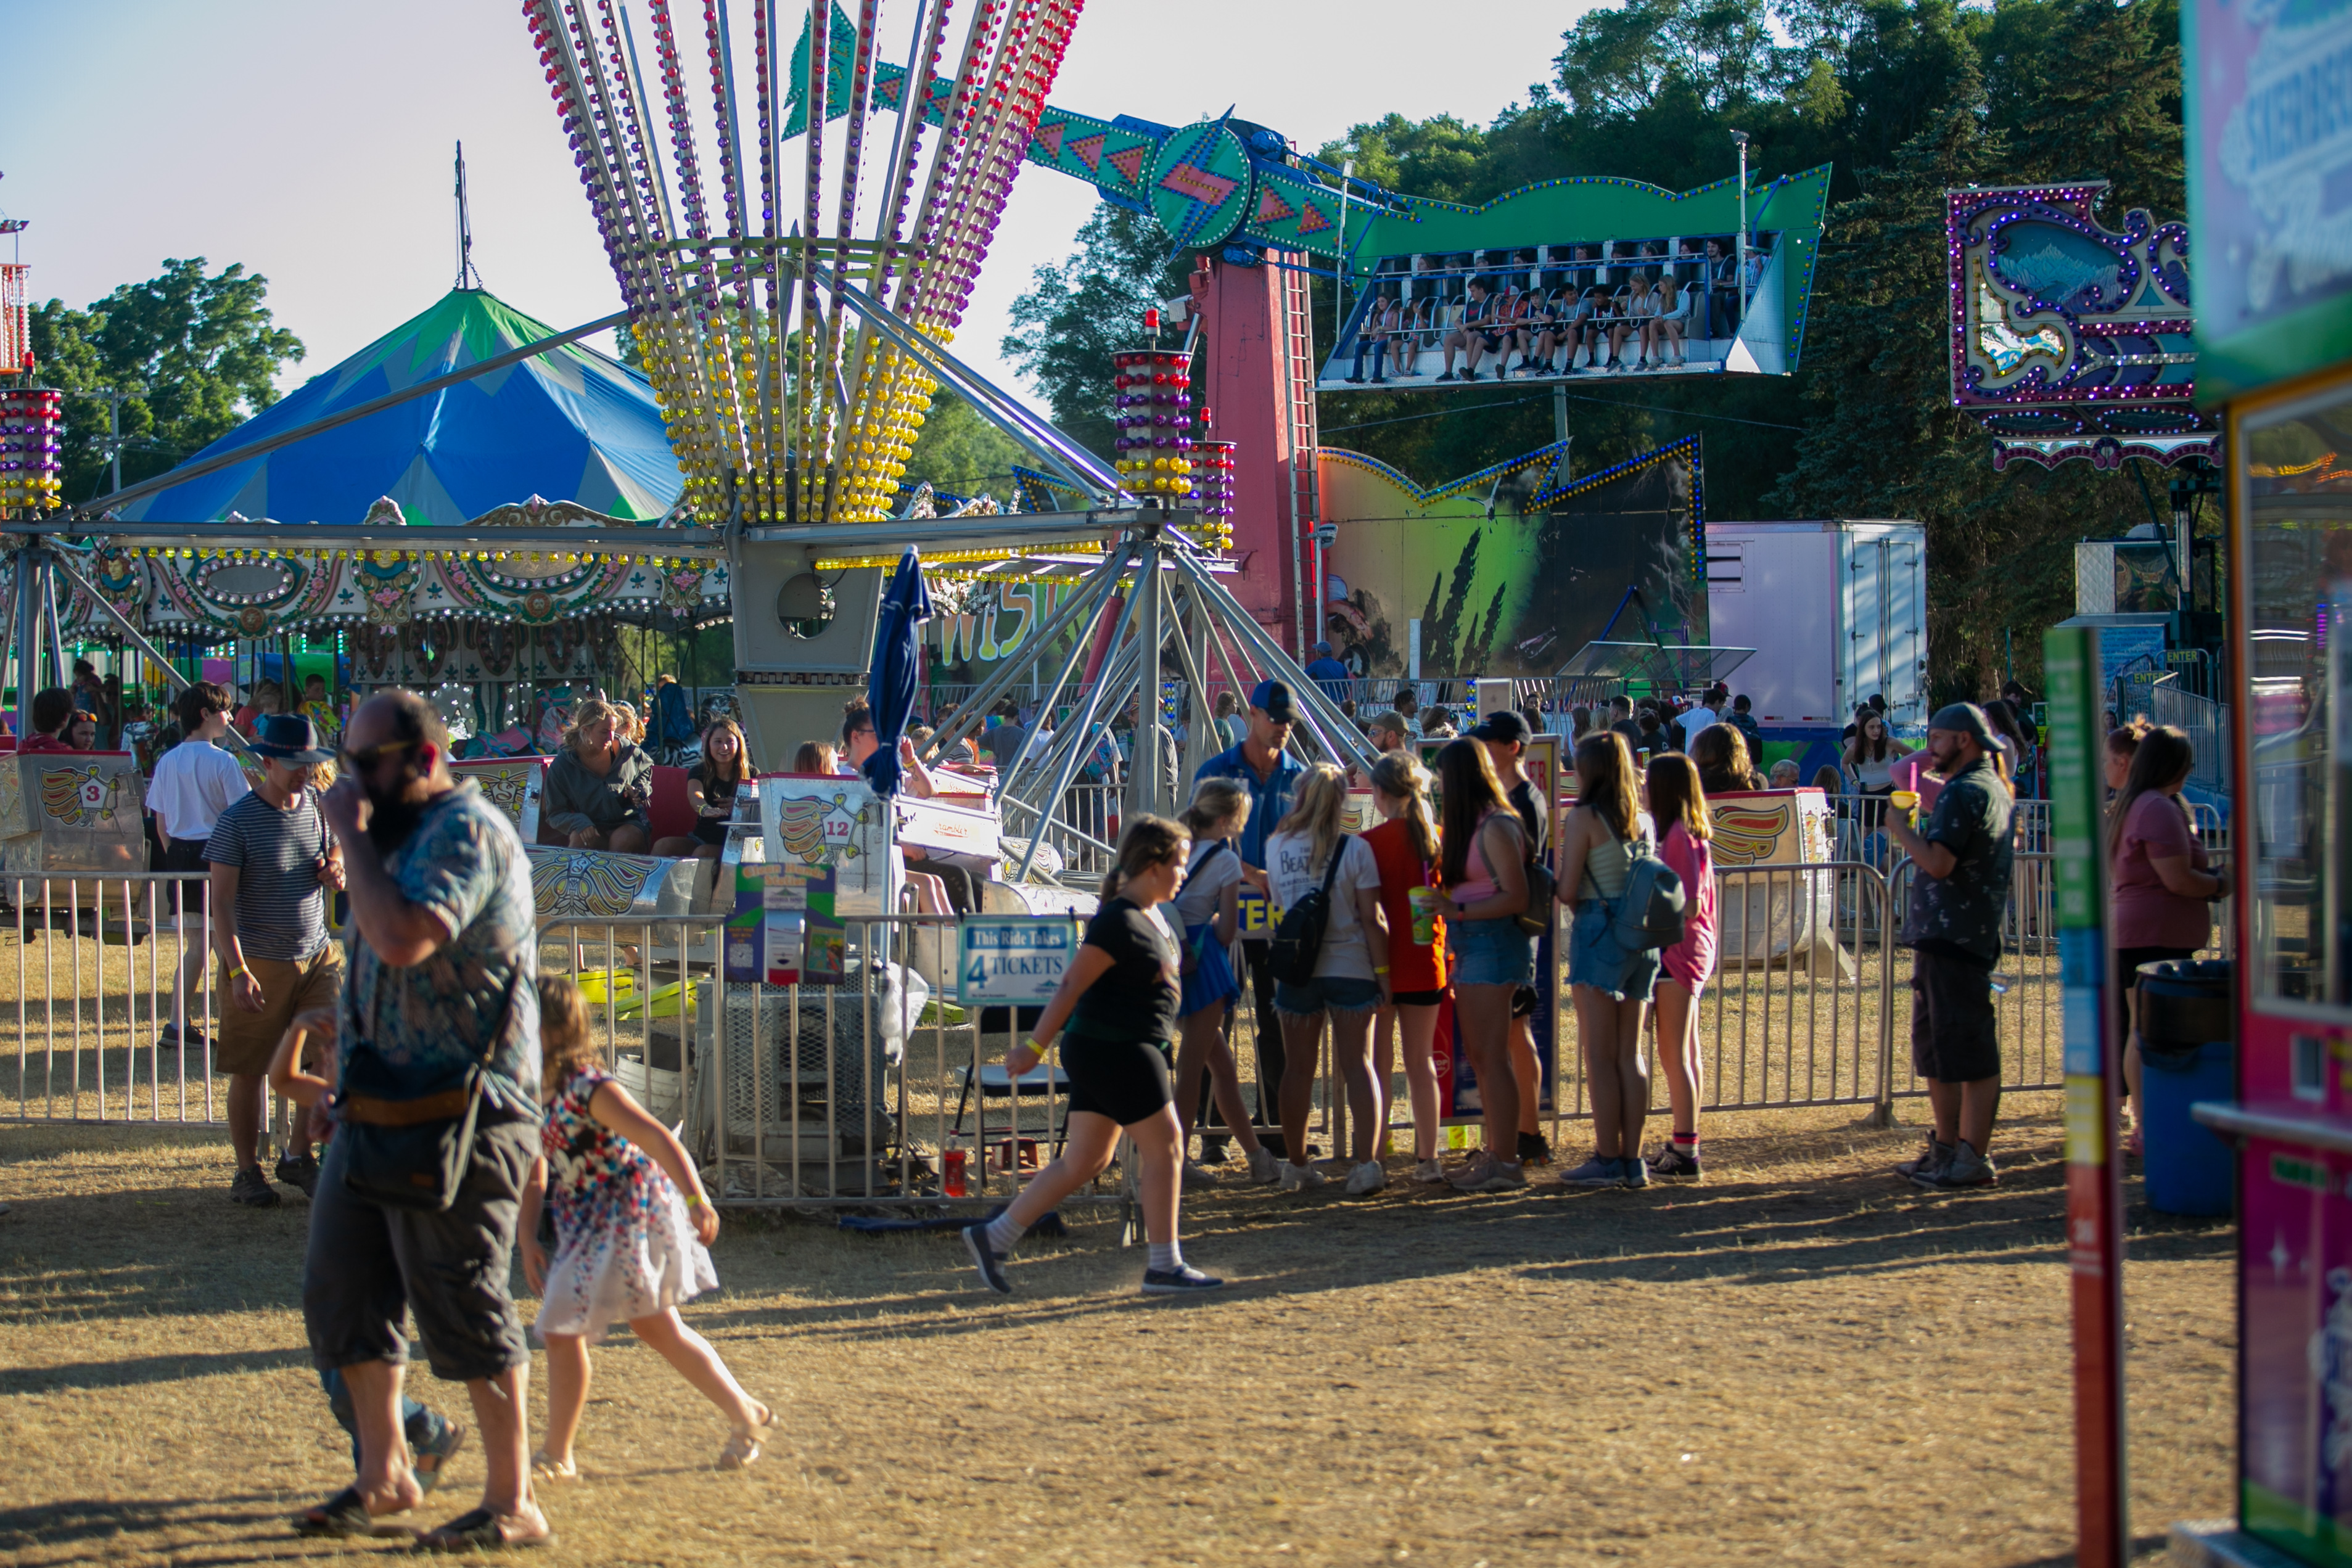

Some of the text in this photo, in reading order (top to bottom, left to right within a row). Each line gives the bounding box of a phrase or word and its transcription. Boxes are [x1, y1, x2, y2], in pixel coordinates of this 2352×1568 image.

[2167, 651, 2197, 662] ENTER
[86, 785, 100, 802] 3
[827, 821, 849, 836] 12
[742, 863, 828, 880] Clean Hands
[765, 875, 807, 886] Station
[974, 930, 1061, 945] This Ride Takes
[967, 954, 988, 989] 4
[990, 956, 1063, 975] TICKETS
